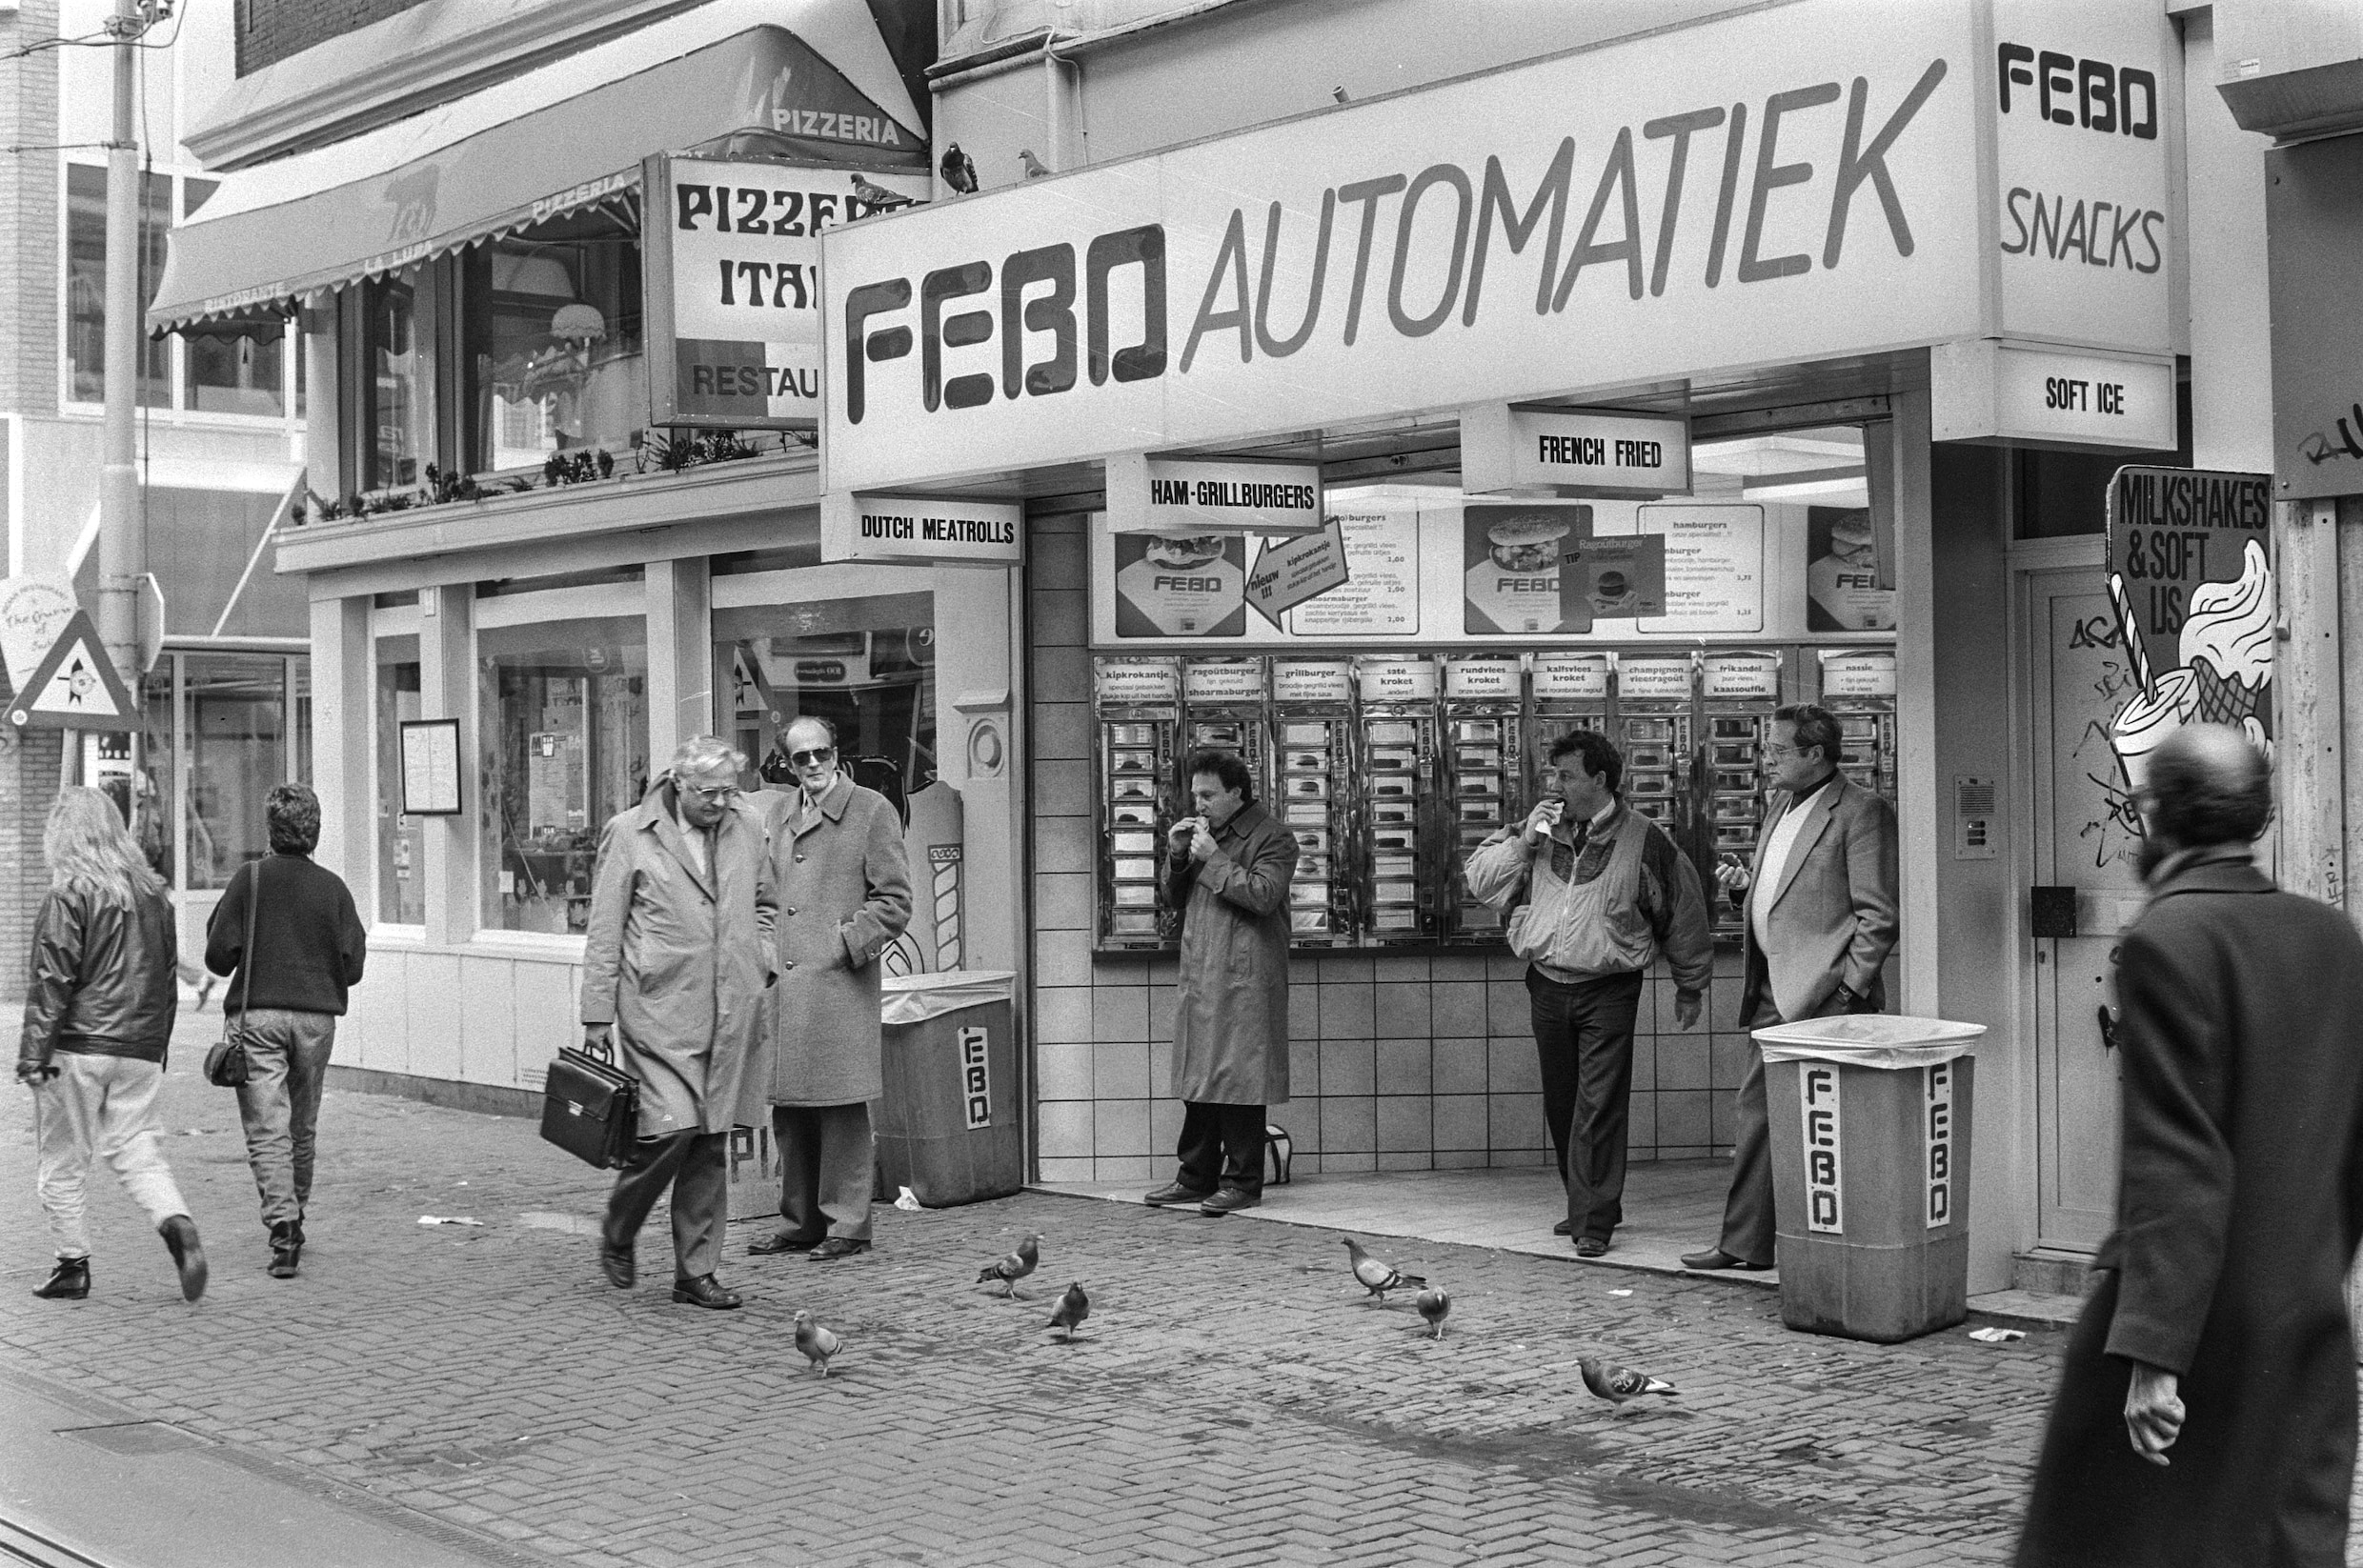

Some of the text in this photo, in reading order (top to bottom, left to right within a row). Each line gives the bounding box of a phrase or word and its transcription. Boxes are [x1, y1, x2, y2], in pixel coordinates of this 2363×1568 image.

[1998, 42, 2158, 140] FEBO
[772, 108, 899, 145] PIZZERIA
[532, 173, 626, 219] PIZZERIA
[1179, 58, 1948, 373] AUTOMATIEK
[2000, 187, 2165, 274] SNACKS
[846, 223, 1167, 425] FEBO
[2046, 376, 2125, 415] SOFT ICE
[1539, 434, 1663, 469] FRENCH FRIED
[1151, 479, 1315, 510] HAM-GRILLBURGERS
[2119, 474, 2268, 531] MILKSHAKES
[860, 514, 1015, 544] DUTCH MEATROLLS
[1286, 540, 1331, 567] kipkrokantje
[1565, 553, 1580, 564] TIP
[2127, 530, 2210, 581] & SOFT
[1154, 576, 1222, 592] FEBO
[1251, 570, 1279, 591] nieuw
[2150, 586, 2182, 636] IJS
[1106, 670, 1169, 680] kipkrokantje
[1285, 669, 1336, 678] grillburger
[1628, 667, 1684, 675] champignon
[1188, 688, 1261, 697] shoarmaburger
[963, 1028, 988, 1124] EBO
[1808, 1070, 1838, 1226] FEBO
[1929, 1063, 1948, 1221] FEBO
